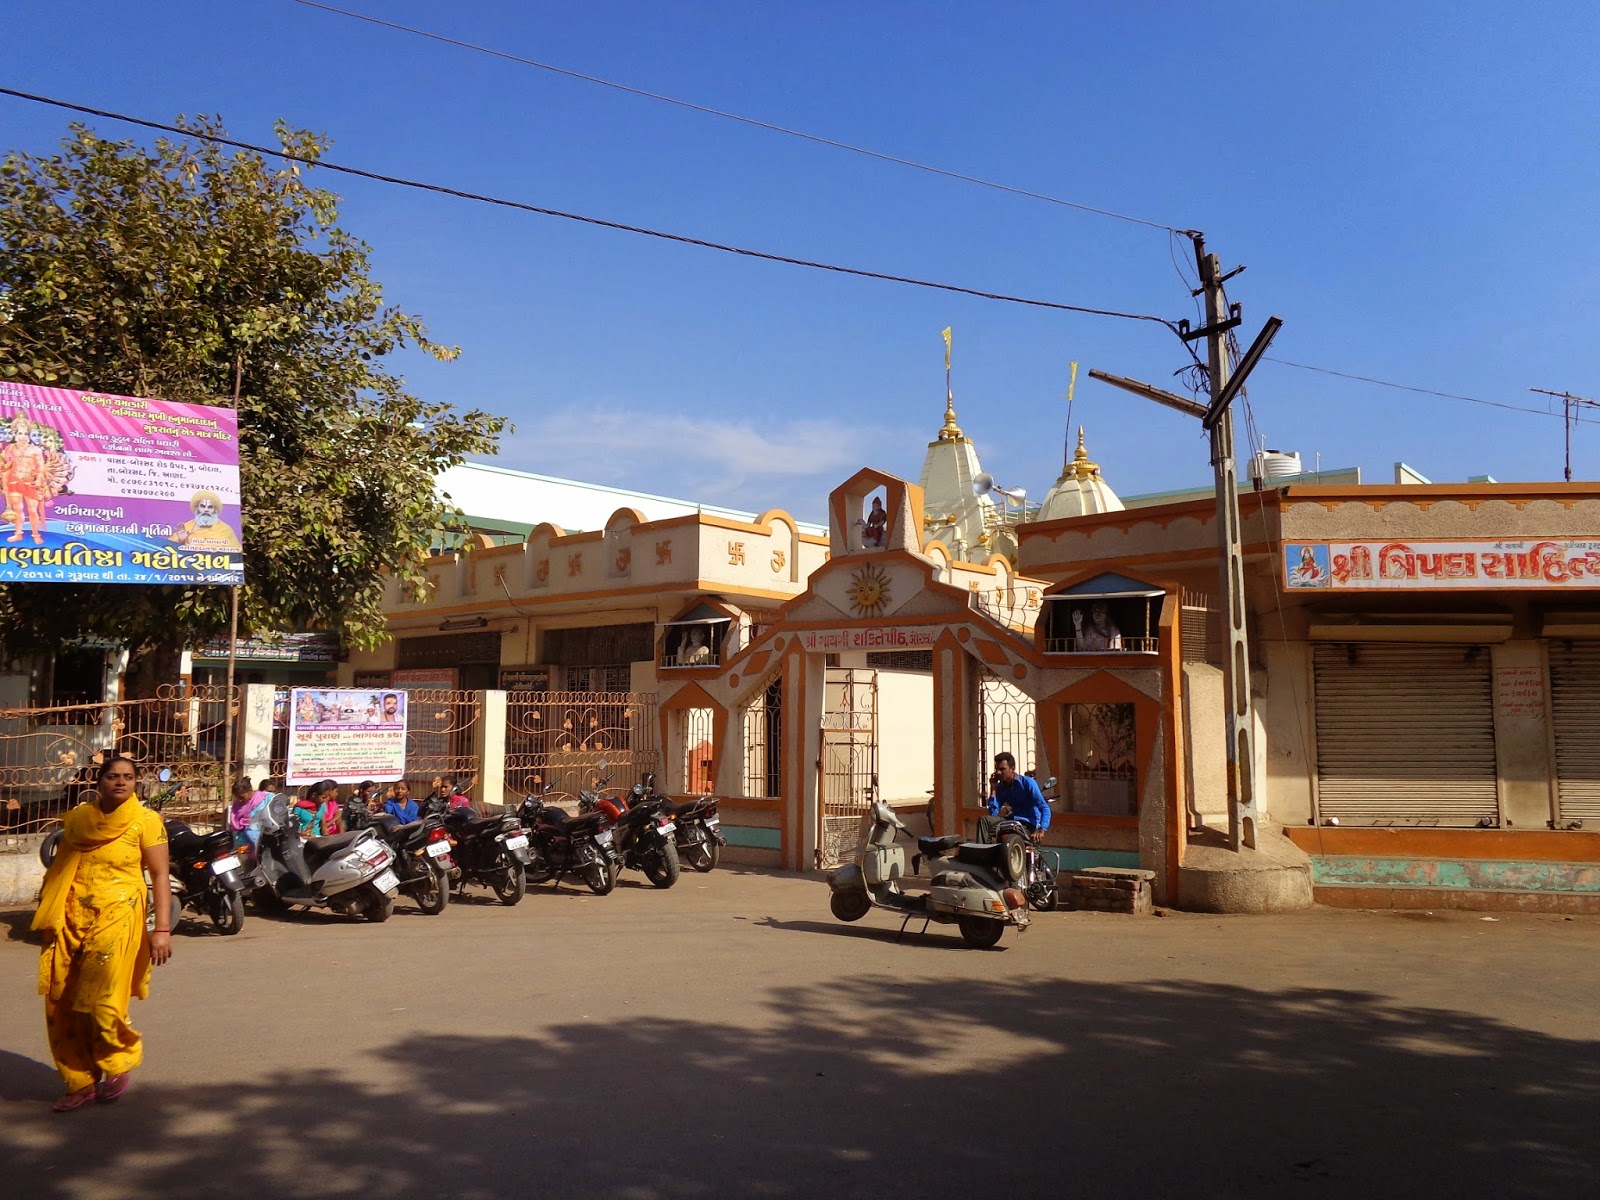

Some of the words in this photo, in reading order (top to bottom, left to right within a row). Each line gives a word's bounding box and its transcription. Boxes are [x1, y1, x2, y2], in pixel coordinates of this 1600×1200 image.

[110, 407, 146, 419] અગિયાર
[147, 411, 166, 423] મુખી
[54, 503, 124, 521] અગિયારમુખી
[65, 522, 138, 536] હનુમાનદાદાની
[140, 523, 173, 539] મૂર્તિનો
[130, 545, 231, 571] મહોત્સવ
[1331, 544, 1373, 585] શ્રી
[1379, 543, 1478, 580] ત્રિપદા
[102, 570, 114, 580] થી
[806, 631, 817, 649] શ્રી
[818, 629, 850, 649] ગાયત્રી
[297, 731, 313, 742] સૂર્ય
[315, 733, 341, 742] પુરાણ
[352, 732, 384, 740] ભાગવત
[387, 732, 403, 740] કથા
